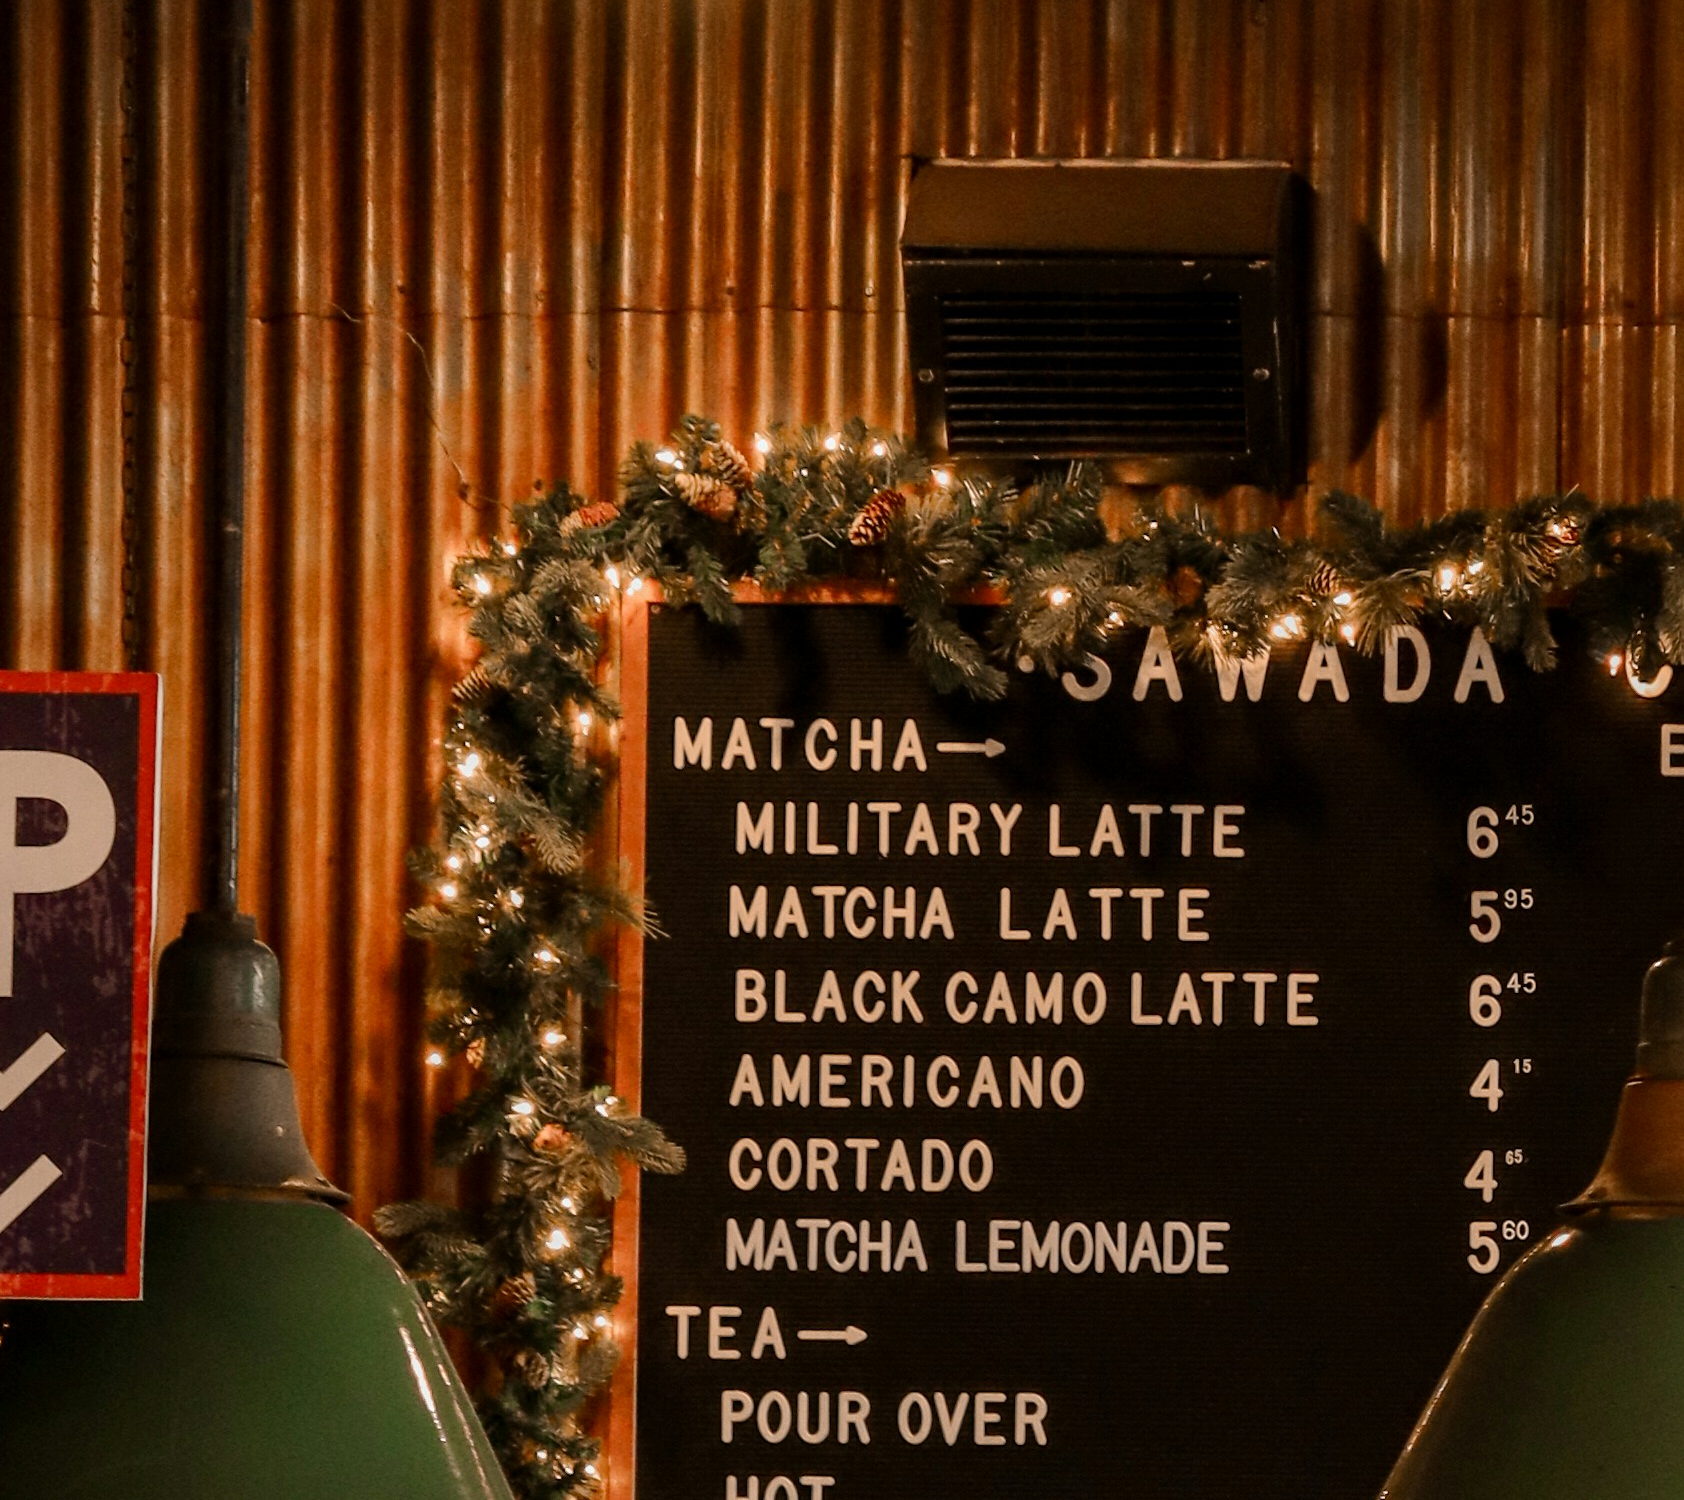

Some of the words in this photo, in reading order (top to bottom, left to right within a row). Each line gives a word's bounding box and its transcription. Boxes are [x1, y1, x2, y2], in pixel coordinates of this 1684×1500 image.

[674, 717, 927, 771] MATCHA
[736, 801, 1022, 857] MILITARY
[1049, 804, 1245, 857] LATTE
[730, 885, 954, 939] MATCHA
[1000, 888, 1210, 941] LATTE
[736, 969, 923, 1023] BLACK
[946, 971, 1106, 1024] CAMO
[1131, 972, 1319, 1026] LATTE
[729, 1054, 1084, 1108] AMERICANO
[729, 1138, 993, 1191] CORTADO
[726, 1218, 927, 1272] MATCHA
[956, 1220, 1230, 1273] LEMONADE
[665, 1306, 786, 1359] TEA
[722, 1390, 870, 1444] POUR
[898, 1392, 1047, 1445] OVER
